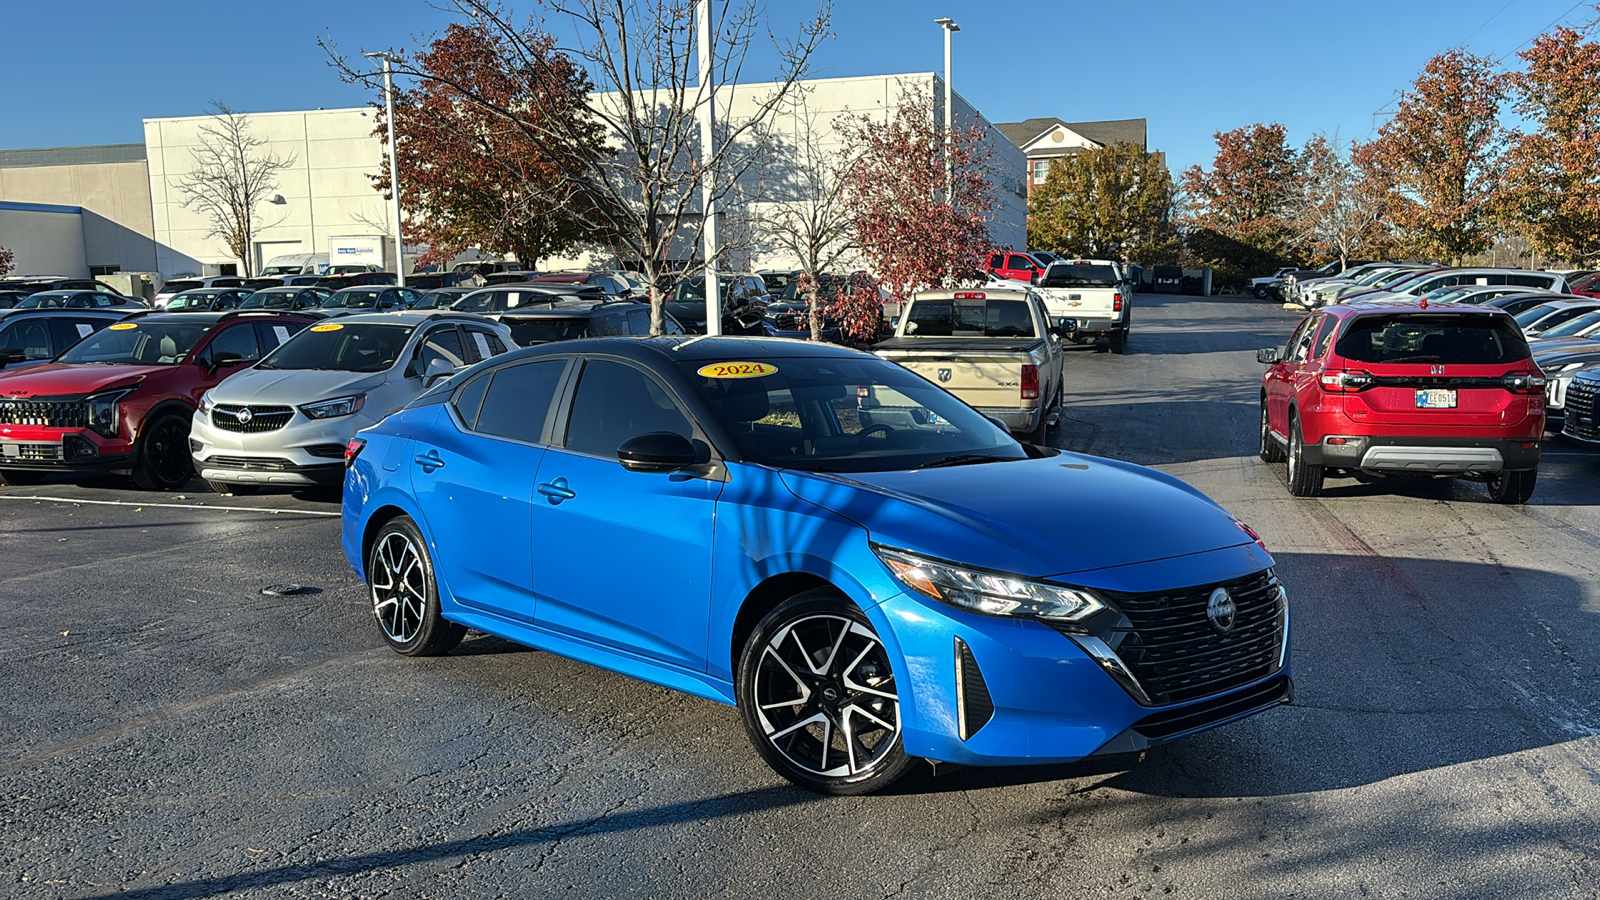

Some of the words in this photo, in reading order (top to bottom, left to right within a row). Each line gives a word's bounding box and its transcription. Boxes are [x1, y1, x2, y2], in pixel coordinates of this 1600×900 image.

[714, 364, 765, 376] 2024
[1397, 377, 1477, 385] PILOT
[1209, 603, 1236, 616] NISSAN
